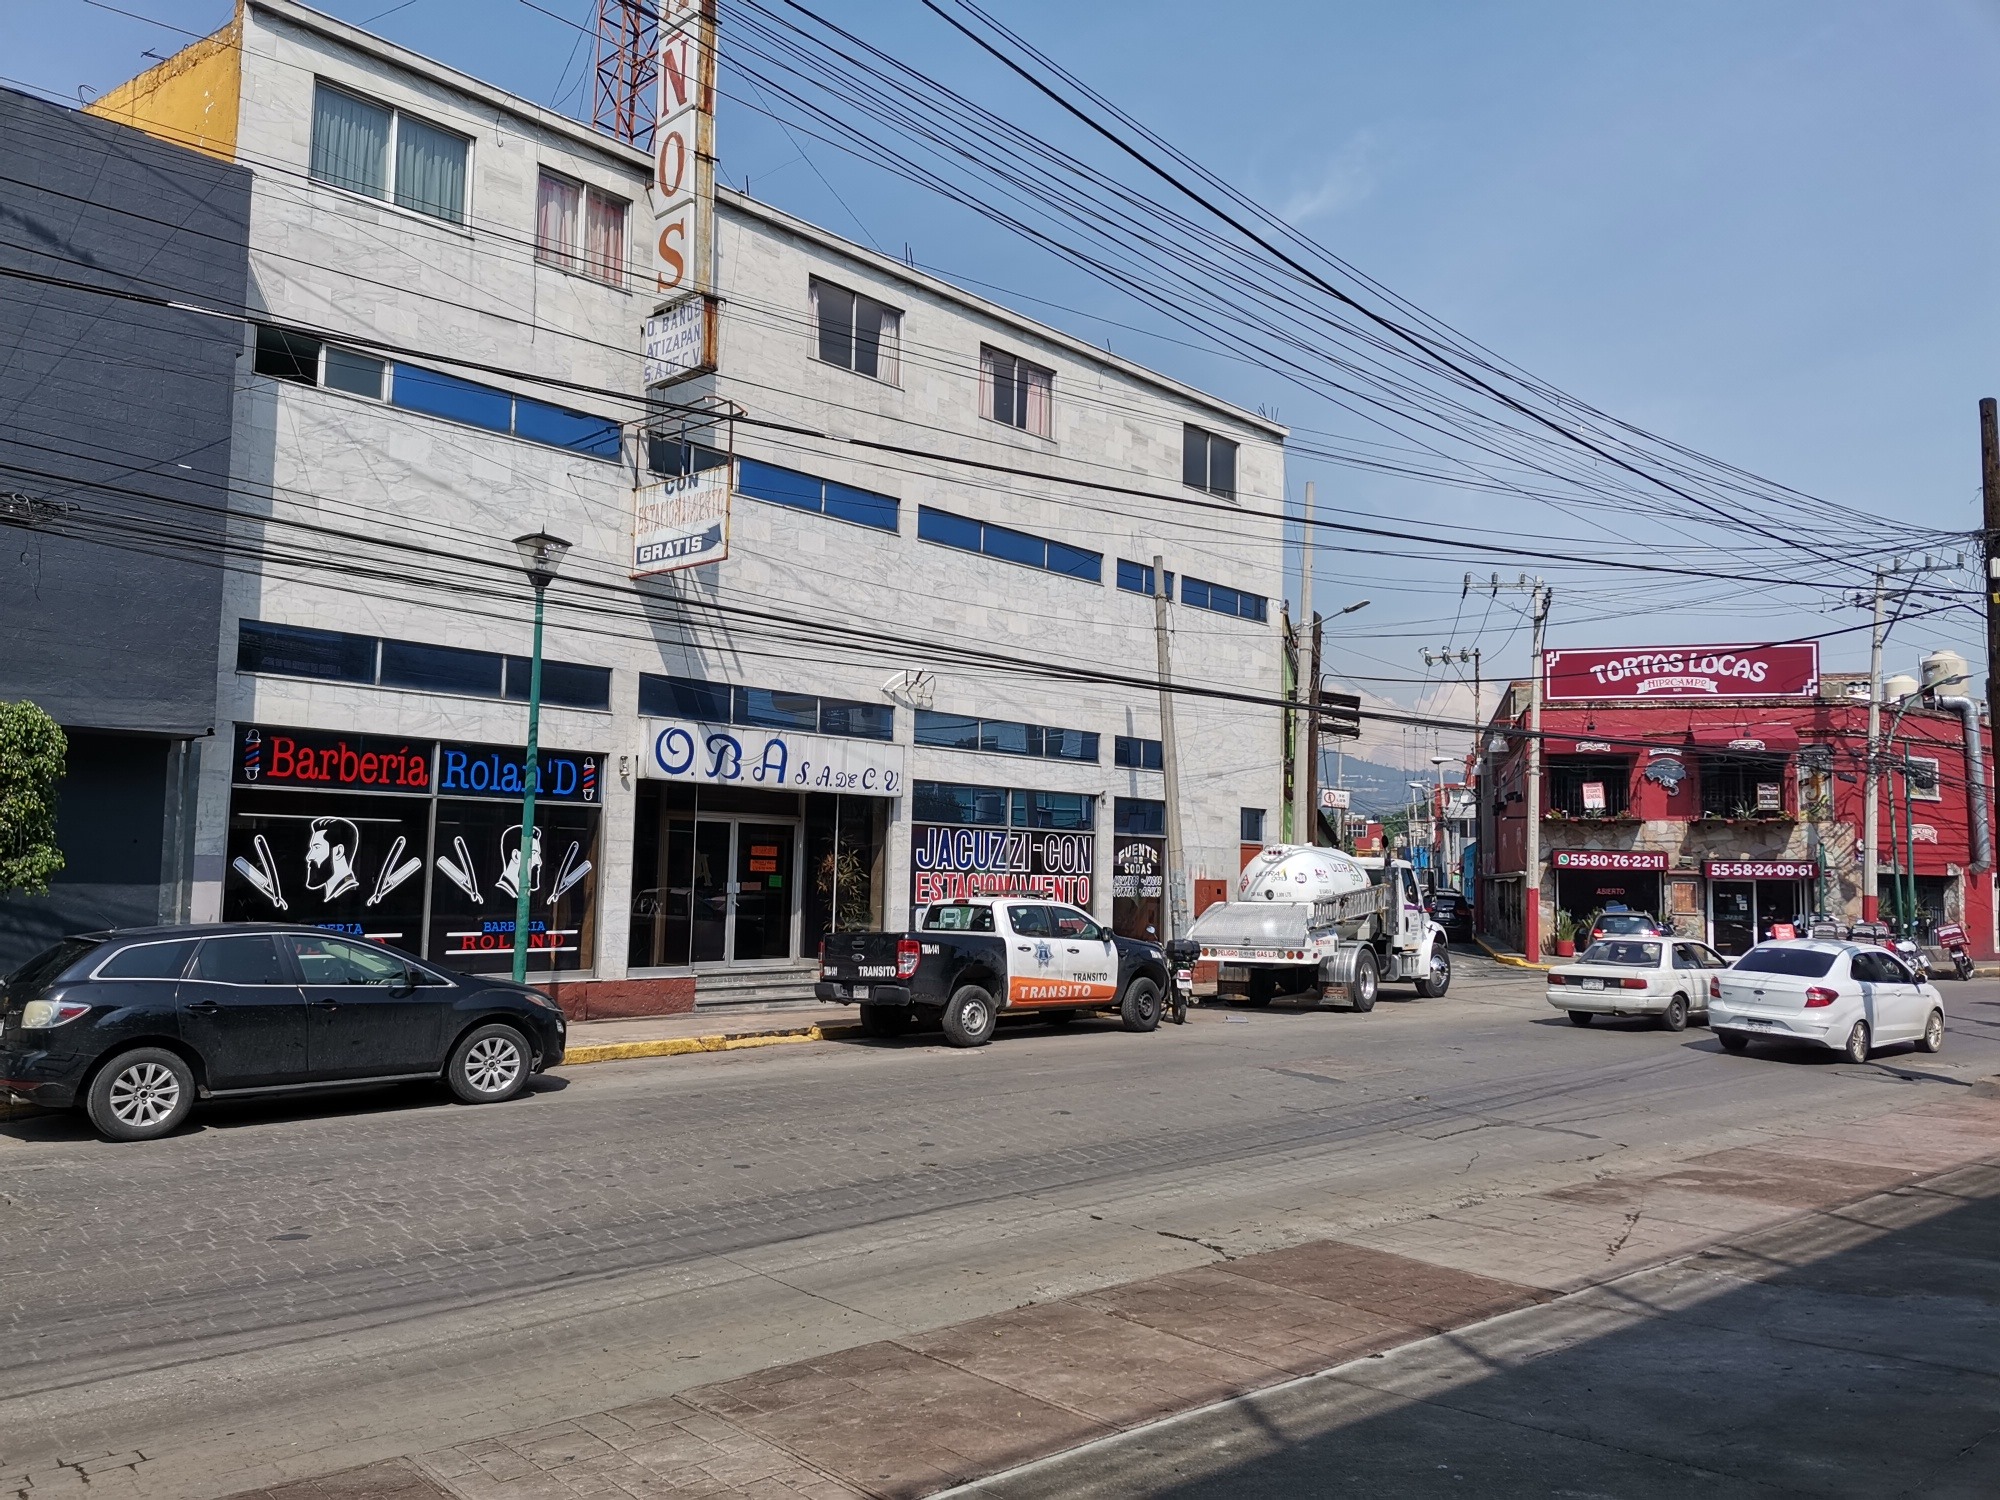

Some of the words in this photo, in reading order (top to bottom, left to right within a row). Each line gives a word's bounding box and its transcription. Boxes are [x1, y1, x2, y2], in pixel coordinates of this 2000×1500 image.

[647, 323, 701, 359] ATIZAPAN
[664, 474, 698, 495] CON
[640, 535, 702, 562] GRATIS
[1590, 653, 1684, 684] TORTAS
[1689, 652, 1768, 682] LOCAS
[1647, 677, 1707, 688] HIPOCAMPO
[267, 735, 429, 787] Barbería
[1118, 843, 1158, 864] FUENTE
[1124, 863, 1152, 874] SODAS
[1329, 862, 1354, 873] ULTRA
[915, 872, 1090, 904] ESTACIONAMIENTO
[1596, 887, 1626, 895] ABIERTO
[483, 921, 545, 932] BARBIA
[462, 934, 564, 950] ROLN'D
[1218, 949, 1238, 957] PELIGRO
[858, 966, 897, 977] TRANSITO
[1072, 972, 1108, 982] TRANSITO
[1019, 984, 1092, 999] TRANSITO
